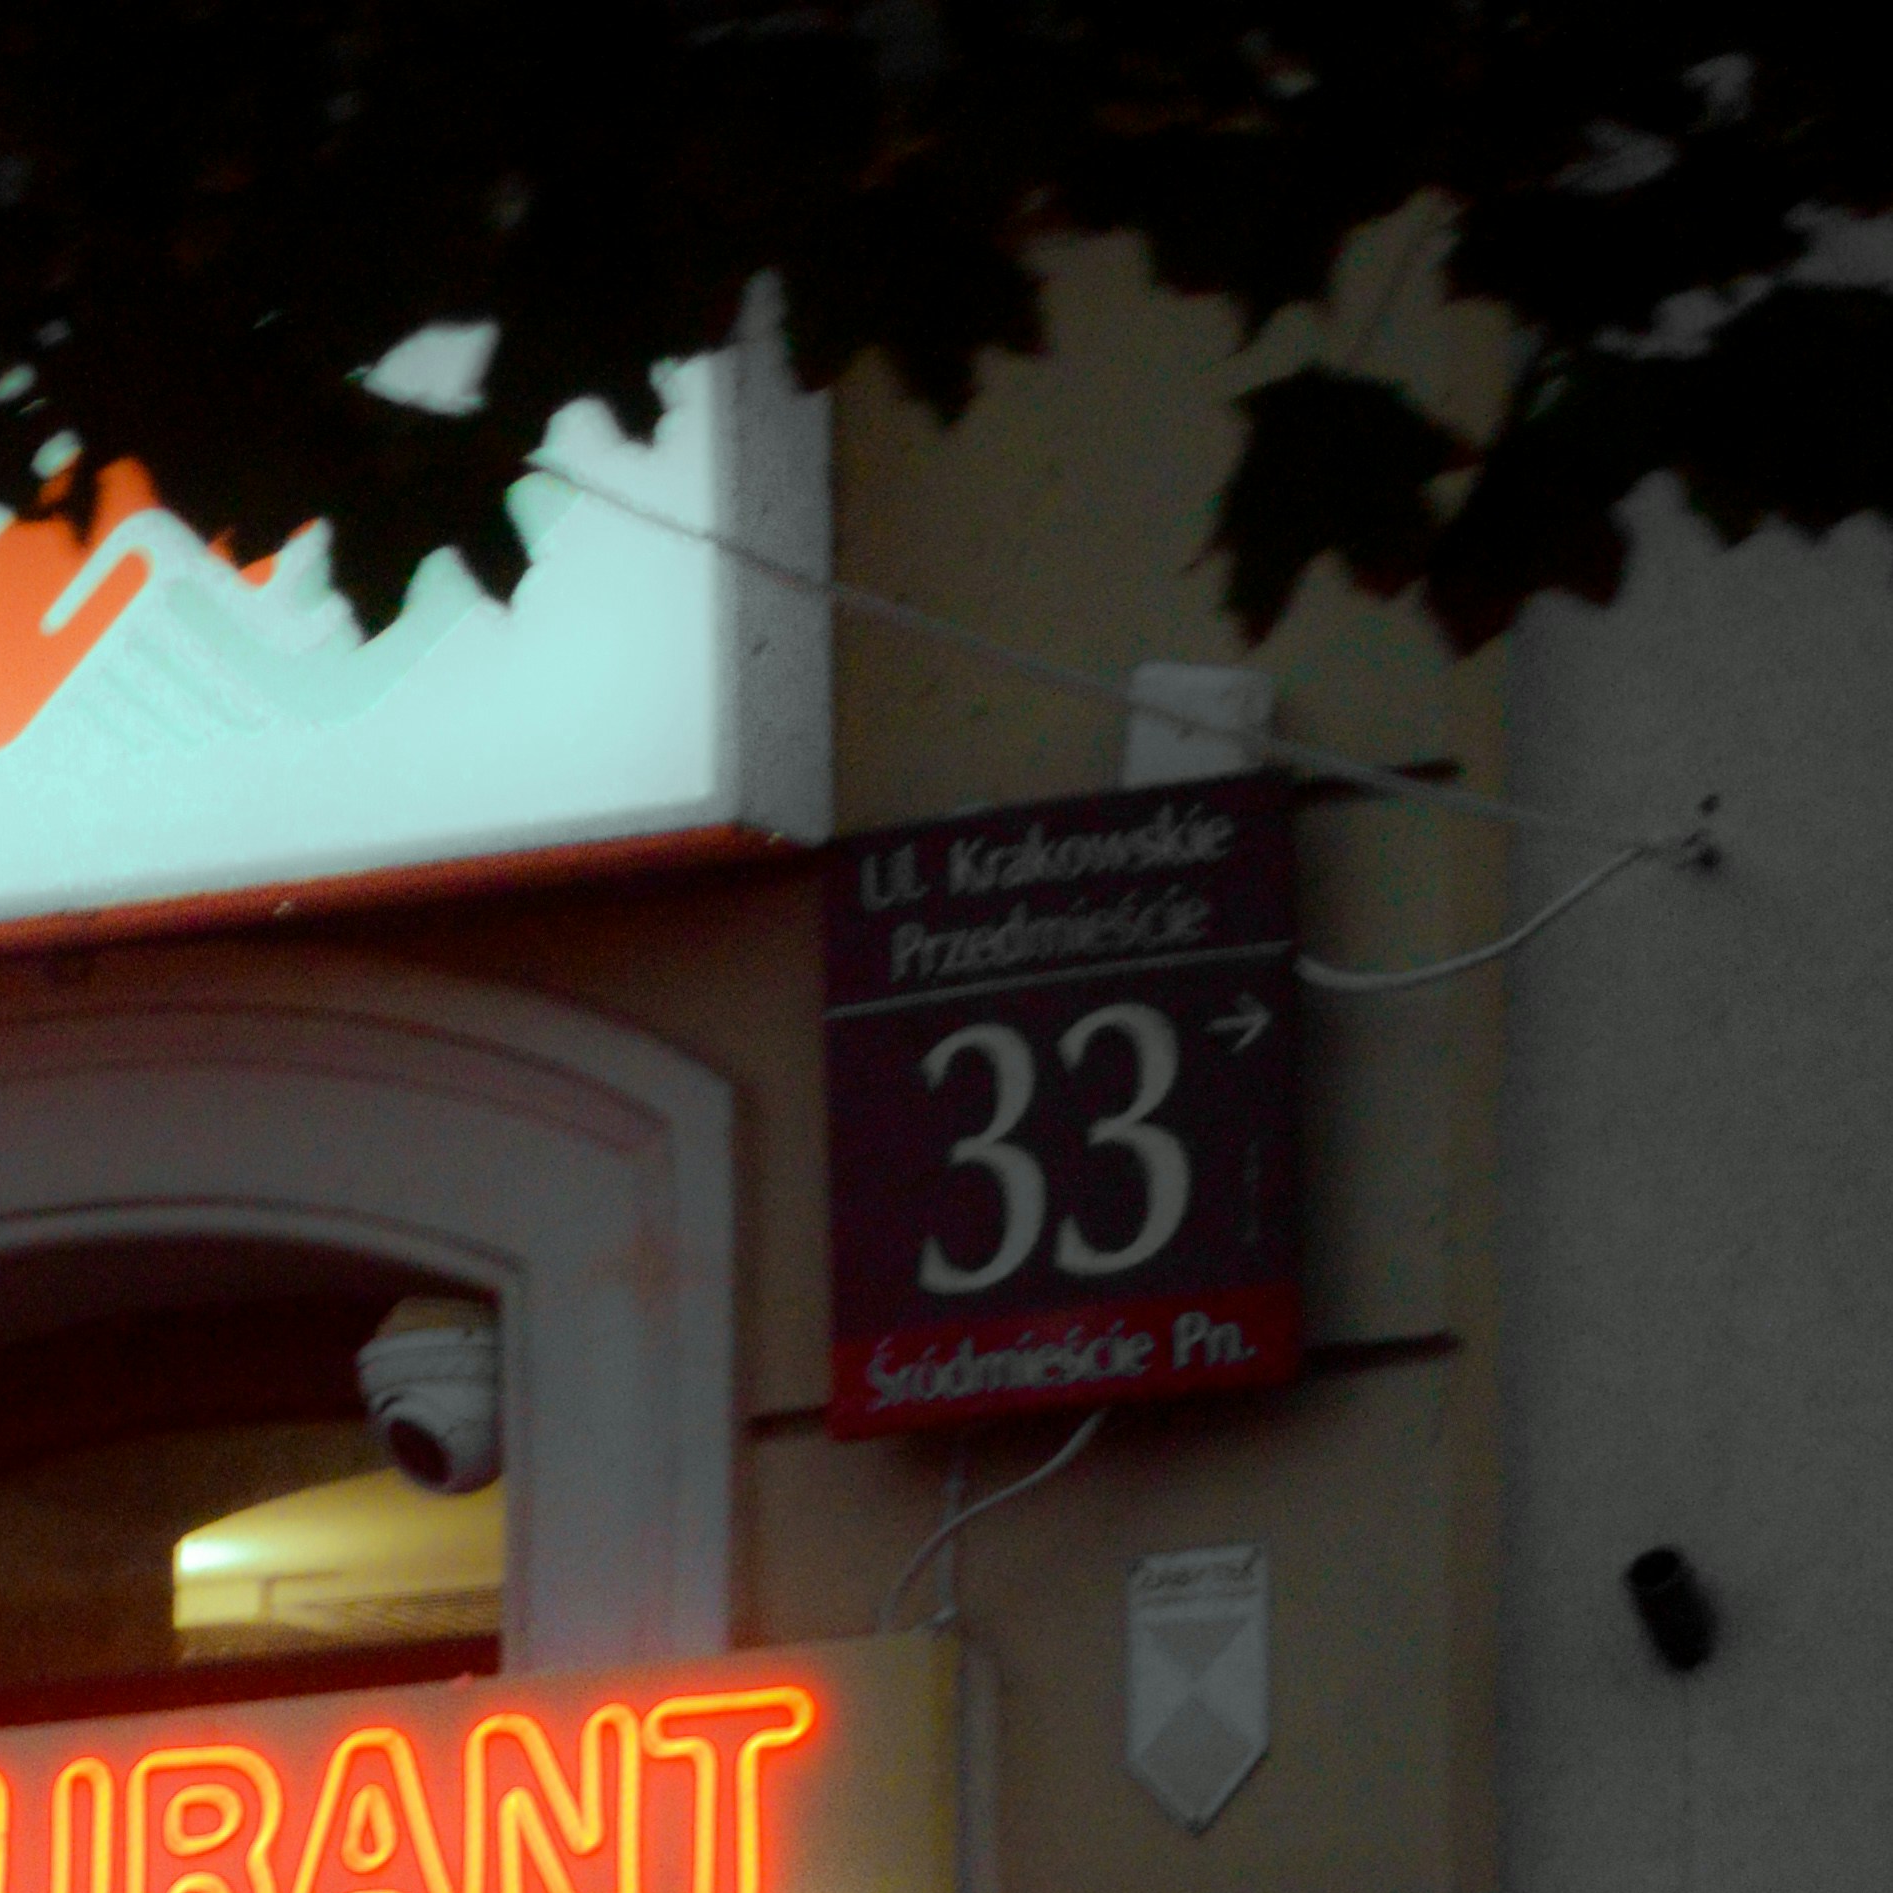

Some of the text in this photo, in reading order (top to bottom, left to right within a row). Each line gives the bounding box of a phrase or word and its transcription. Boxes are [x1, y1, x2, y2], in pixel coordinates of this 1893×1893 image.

[946, 803, 1236, 895] Krakowskie
[889, 884, 1211, 983] Przedmieście
[917, 1001, 1192, 1294] 33
[865, 1310, 1258, 1414] Śródmieście Pn.
